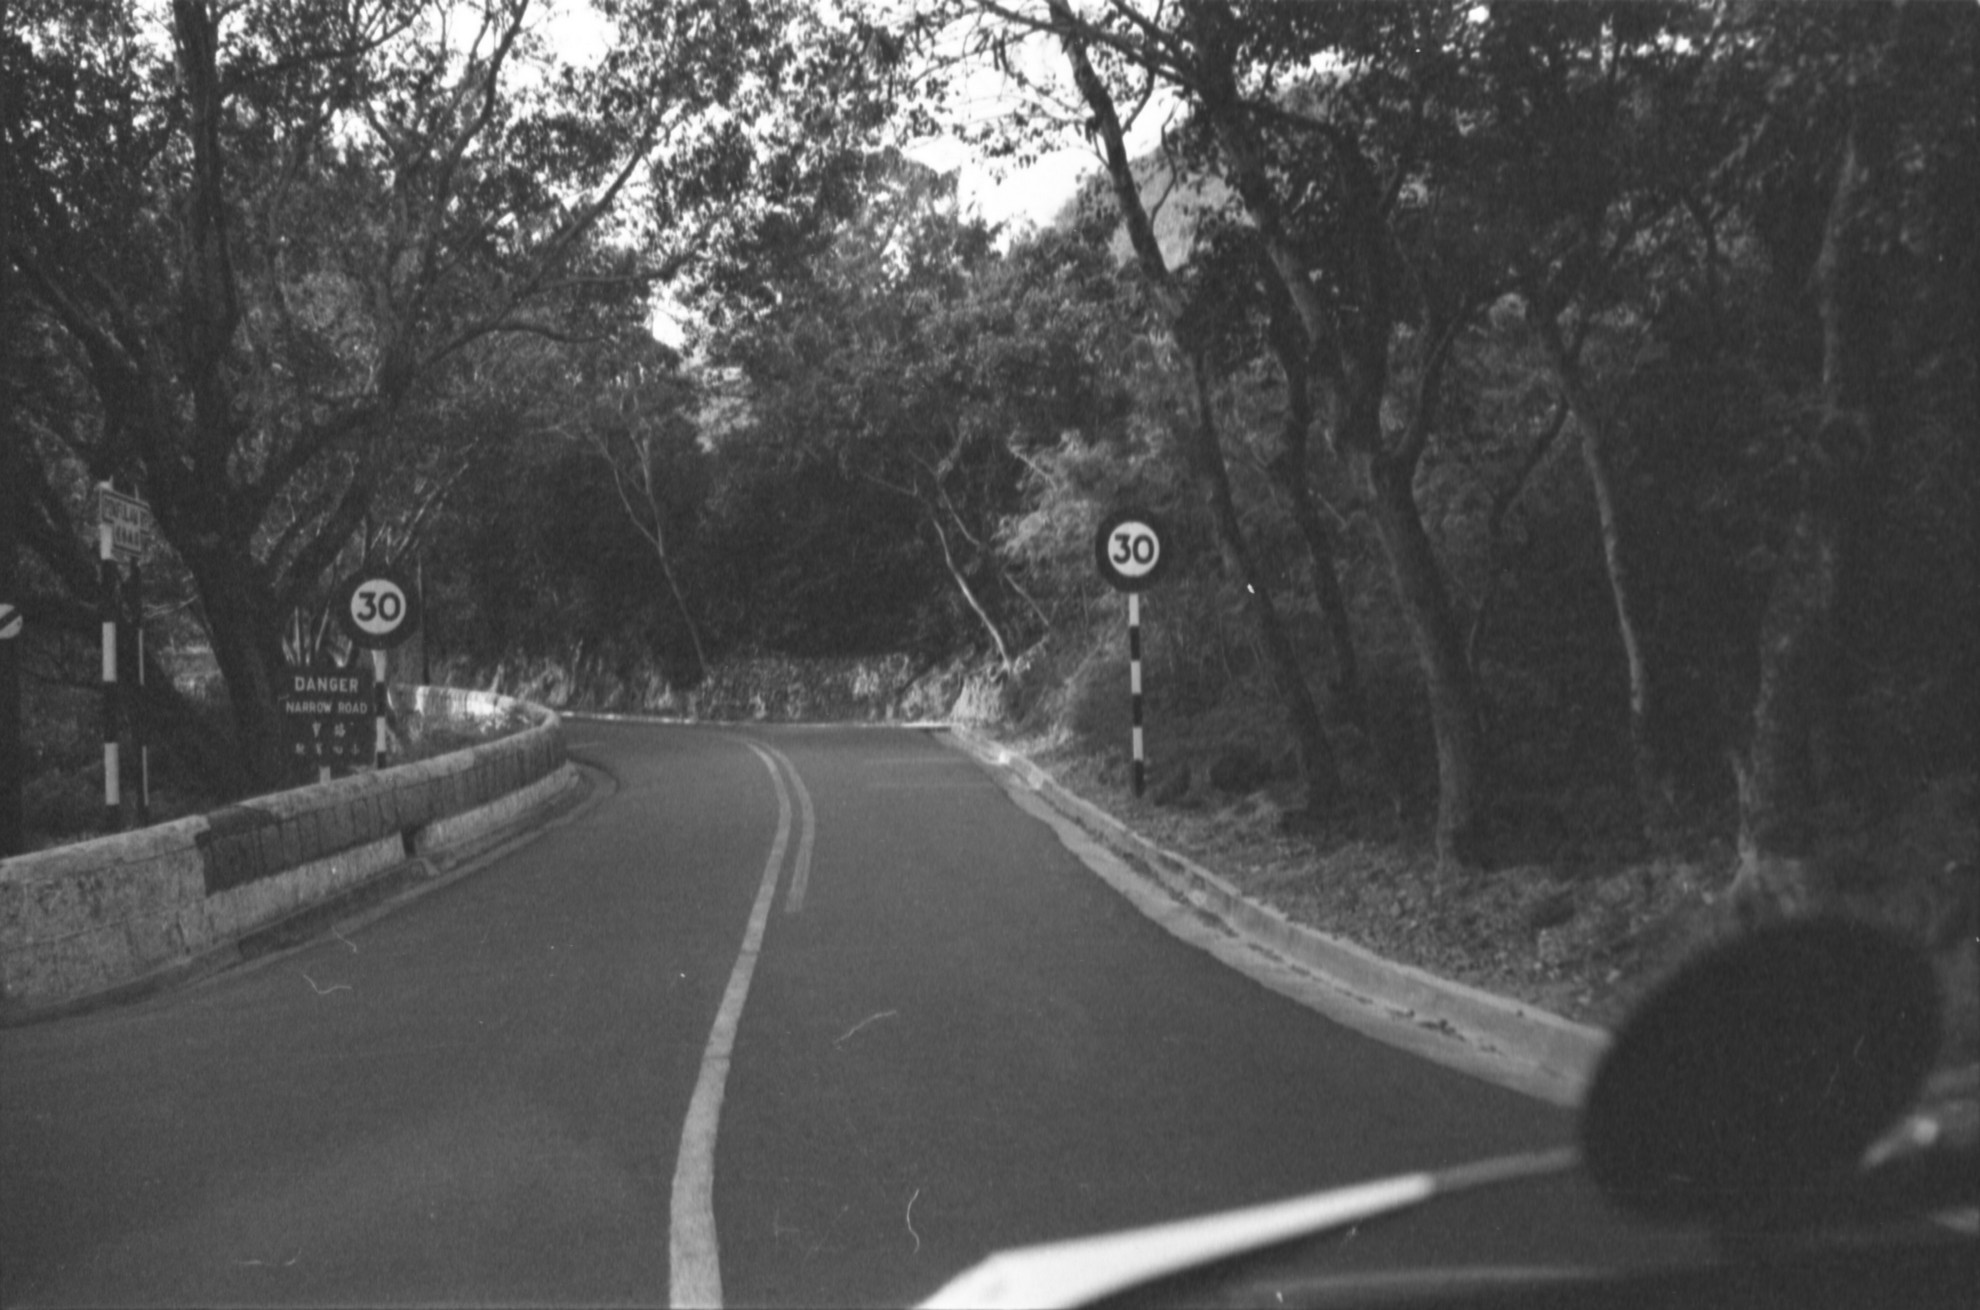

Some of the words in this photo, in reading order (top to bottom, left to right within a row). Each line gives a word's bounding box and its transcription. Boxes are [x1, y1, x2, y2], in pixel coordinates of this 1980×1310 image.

[1113, 533, 1155, 565] 30
[357, 591, 401, 622] 30
[294, 676, 359, 693] DANGER
[285, 701, 332, 714] NARROW
[338, 702, 368, 715] ROAD
